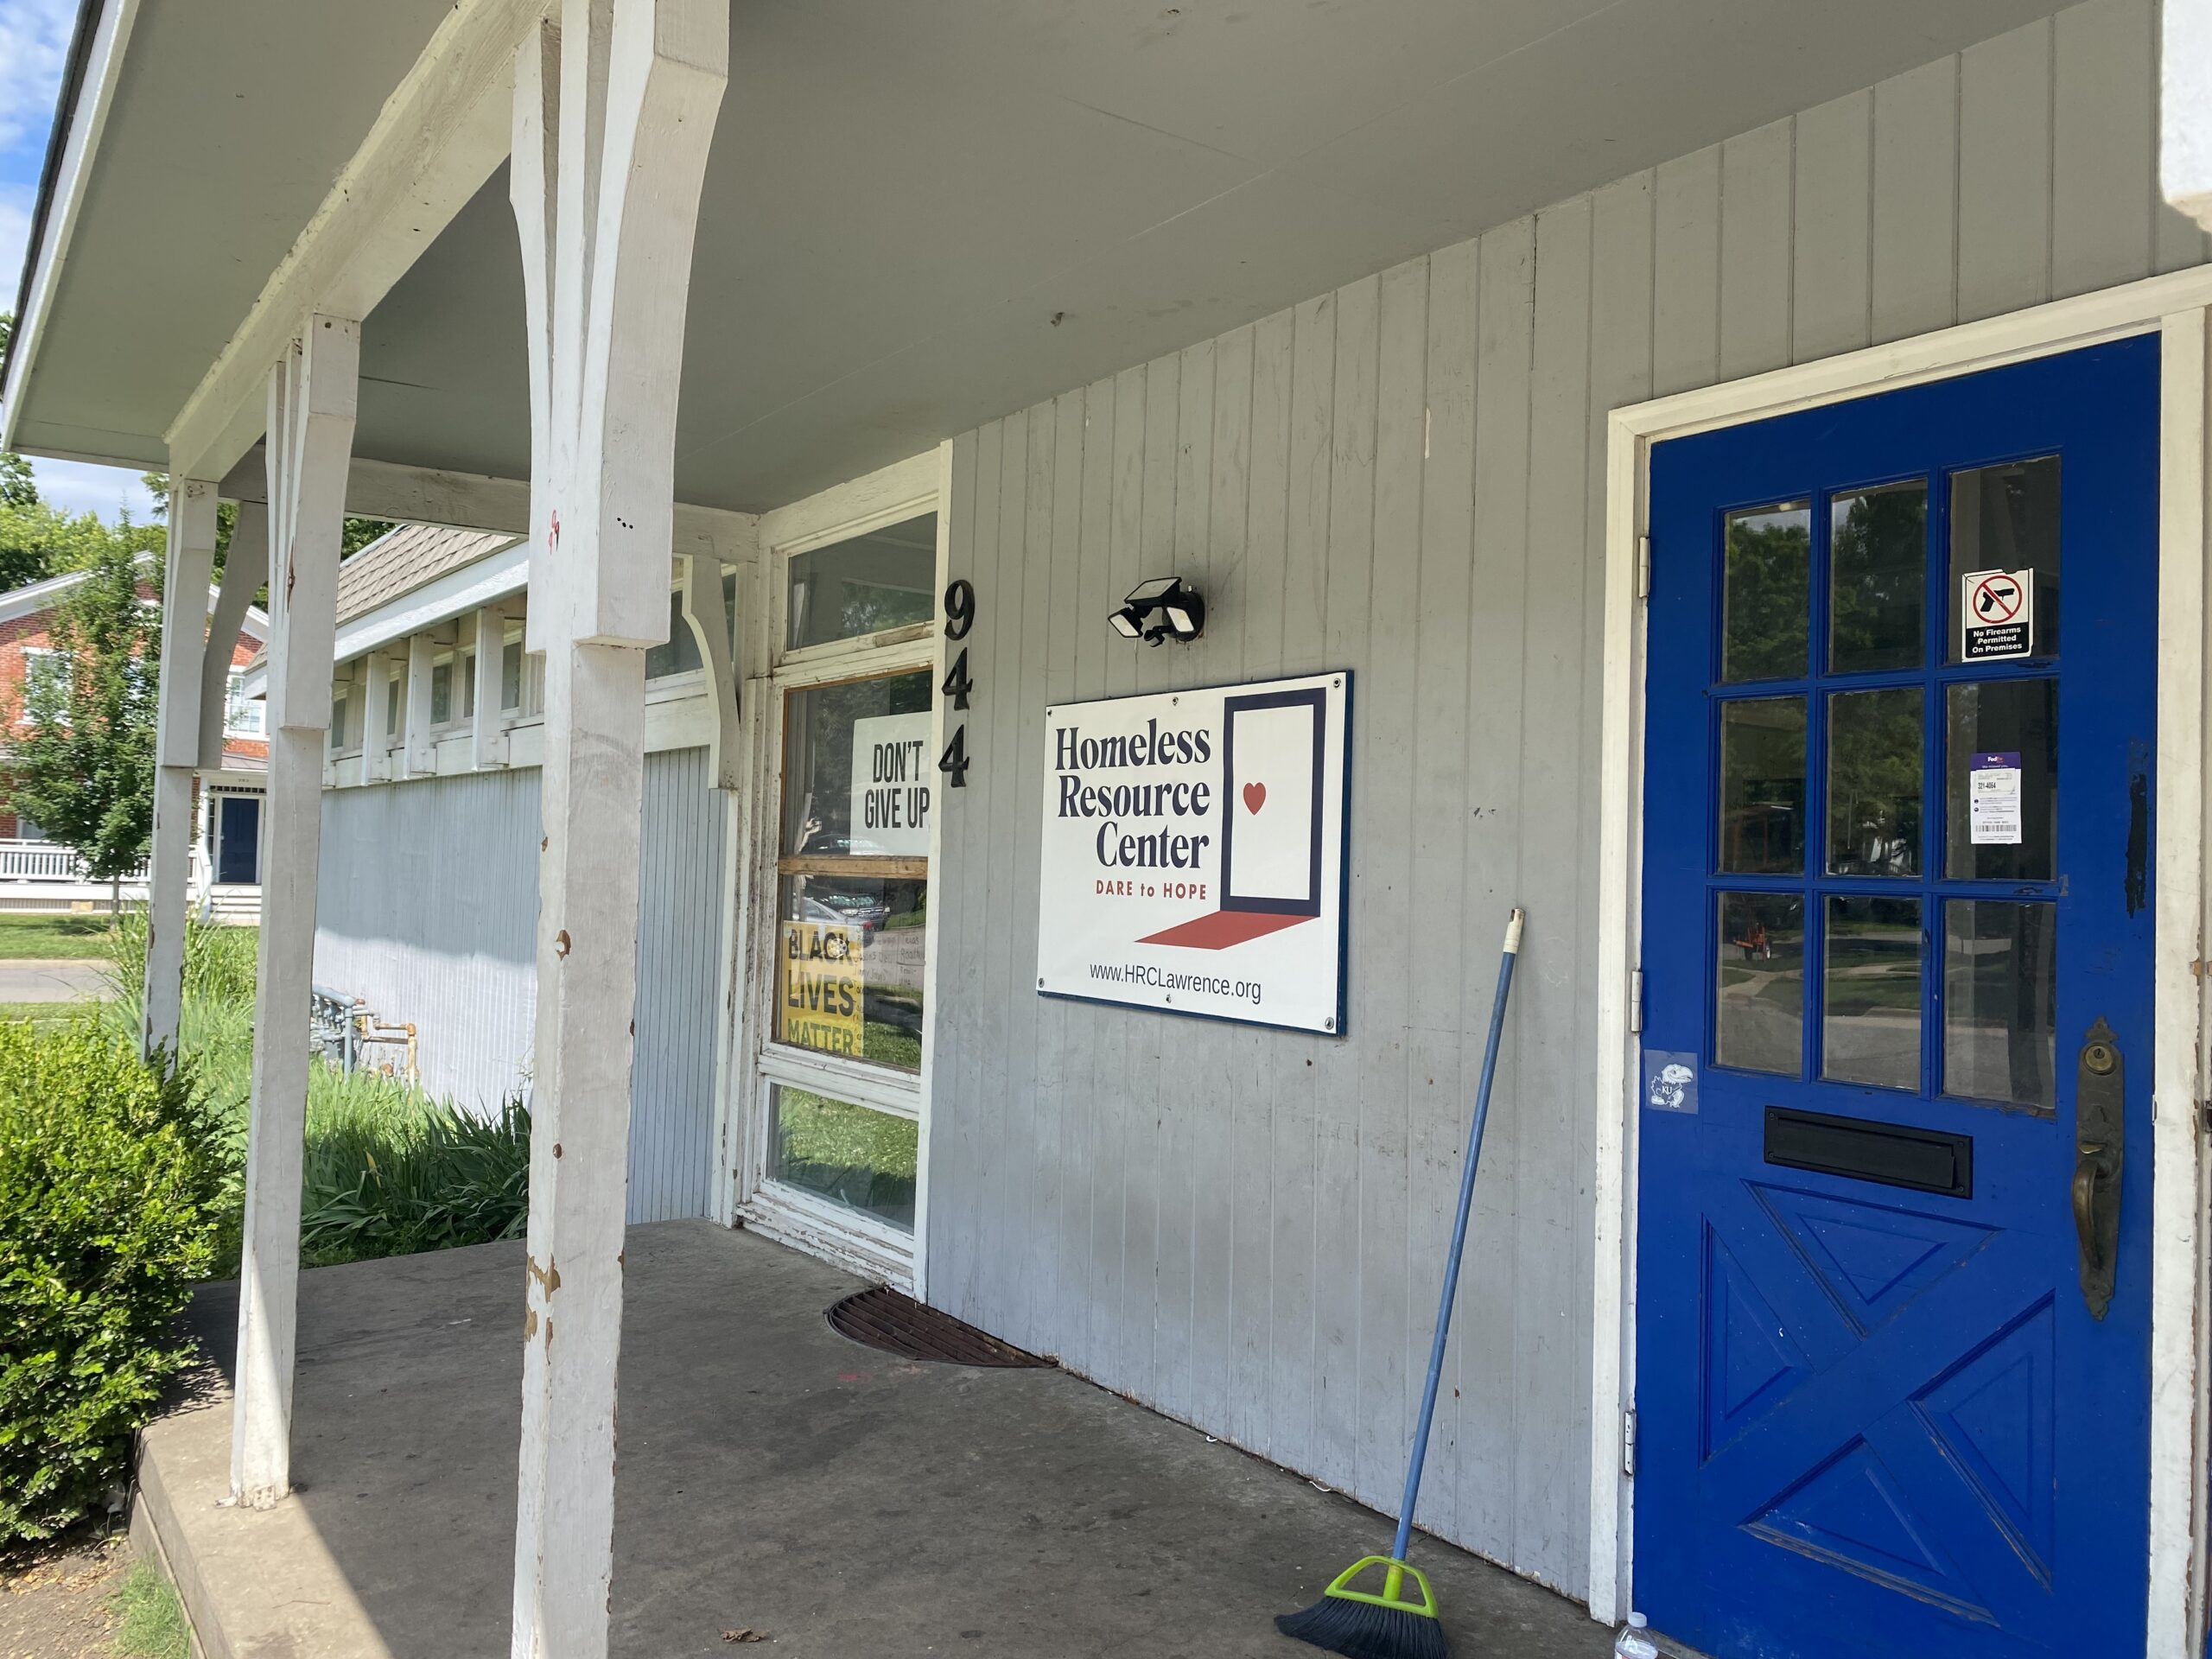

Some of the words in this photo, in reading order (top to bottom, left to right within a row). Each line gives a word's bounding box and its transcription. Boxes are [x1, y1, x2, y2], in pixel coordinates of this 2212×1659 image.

[1978, 635, 2017, 645] Permitted
[1986, 626, 2021, 636] Firearms
[1986, 643, 2022, 652] Premises
[938, 580, 975, 787] 944
[873, 741, 924, 783] DON'T
[1054, 717, 1211, 770] Homeless
[865, 788, 901, 829] GIVE
[907, 787, 930, 829] UP
[1058, 775, 1211, 817] Resource
[1096, 821, 1210, 869] Center
[1096, 880, 1133, 896] DARE
[1141, 883, 1154, 897] to
[1163, 882, 1206, 900] HOPE
[788, 929, 853, 966] BLACK
[788, 969, 854, 1017] LIVES
[1090, 963, 1262, 1005] www.HRCLawrence.org
[788, 1018, 854, 1055] MATTER
[1662, 1086, 1673, 1095] KU
